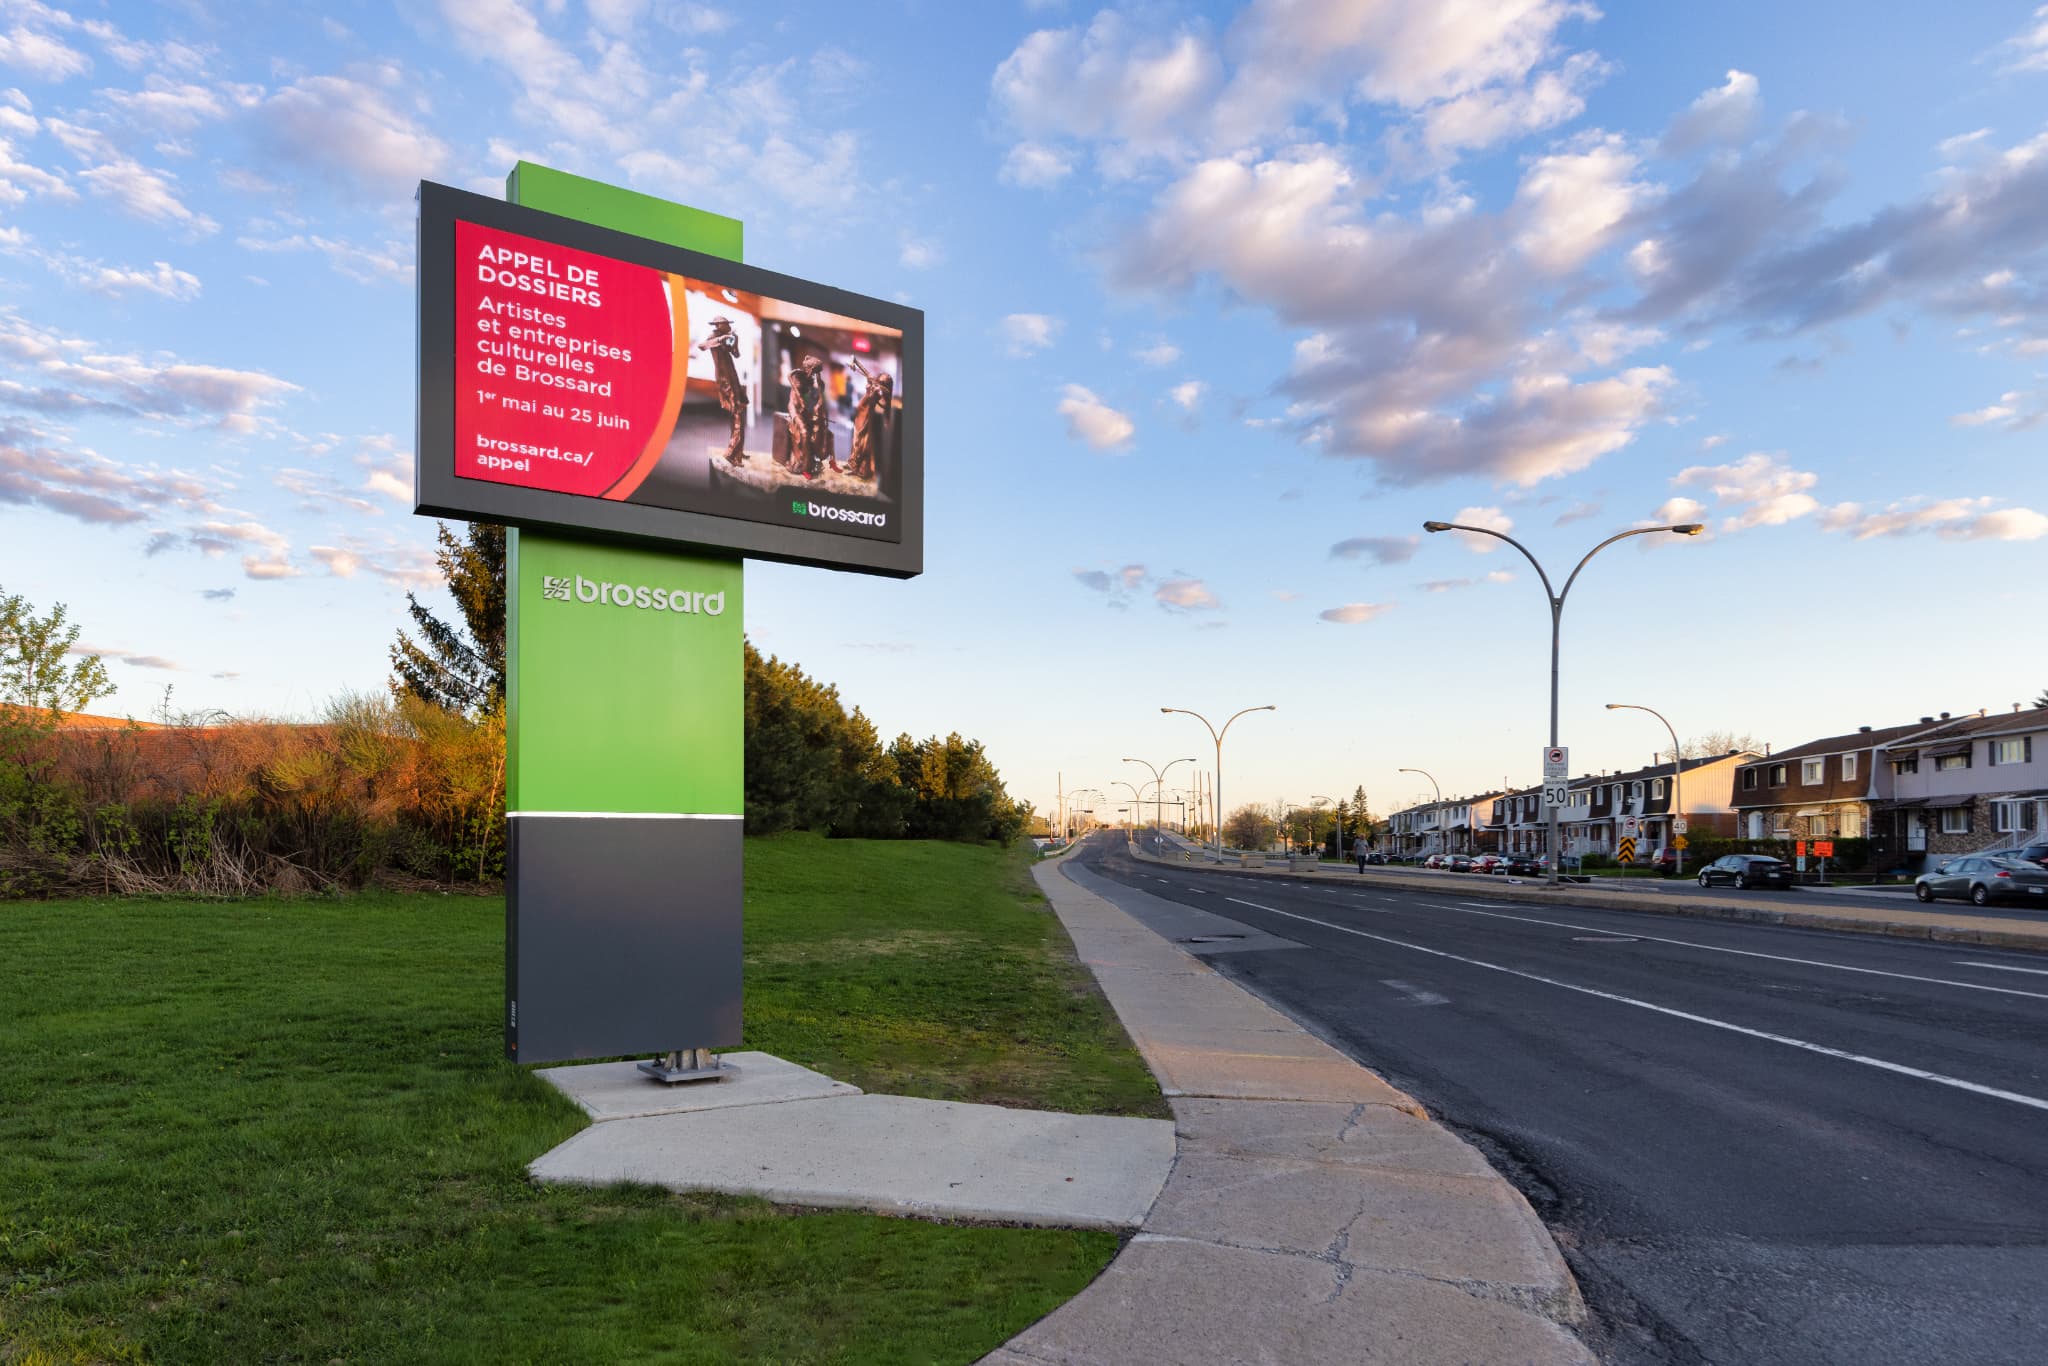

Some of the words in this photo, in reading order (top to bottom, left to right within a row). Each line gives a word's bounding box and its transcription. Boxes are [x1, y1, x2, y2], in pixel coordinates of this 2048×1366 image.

[478, 244, 560, 278] APPEL
[567, 264, 599, 287] DE
[478, 264, 602, 307] DOSSIERS
[478, 296, 567, 328] Artistes
[477, 318, 501, 335] et
[508, 325, 632, 362] entreprises
[477, 339, 594, 374] culturelles
[477, 358, 506, 376] de
[515, 364, 612, 397] Brossard
[477, 390, 497, 403] 1er
[502, 396, 536, 413] mai
[542, 404, 564, 419] au
[570, 407, 592, 423] 25
[596, 412, 630, 430] juin
[476, 433, 594, 466] brossard.ca/
[477, 454, 530, 472] appel
[808, 501, 886, 527] brossard
[575, 573, 725, 616] brossard
[1546, 787, 1566, 803] 50
[1673, 822, 1686, 830] 40
